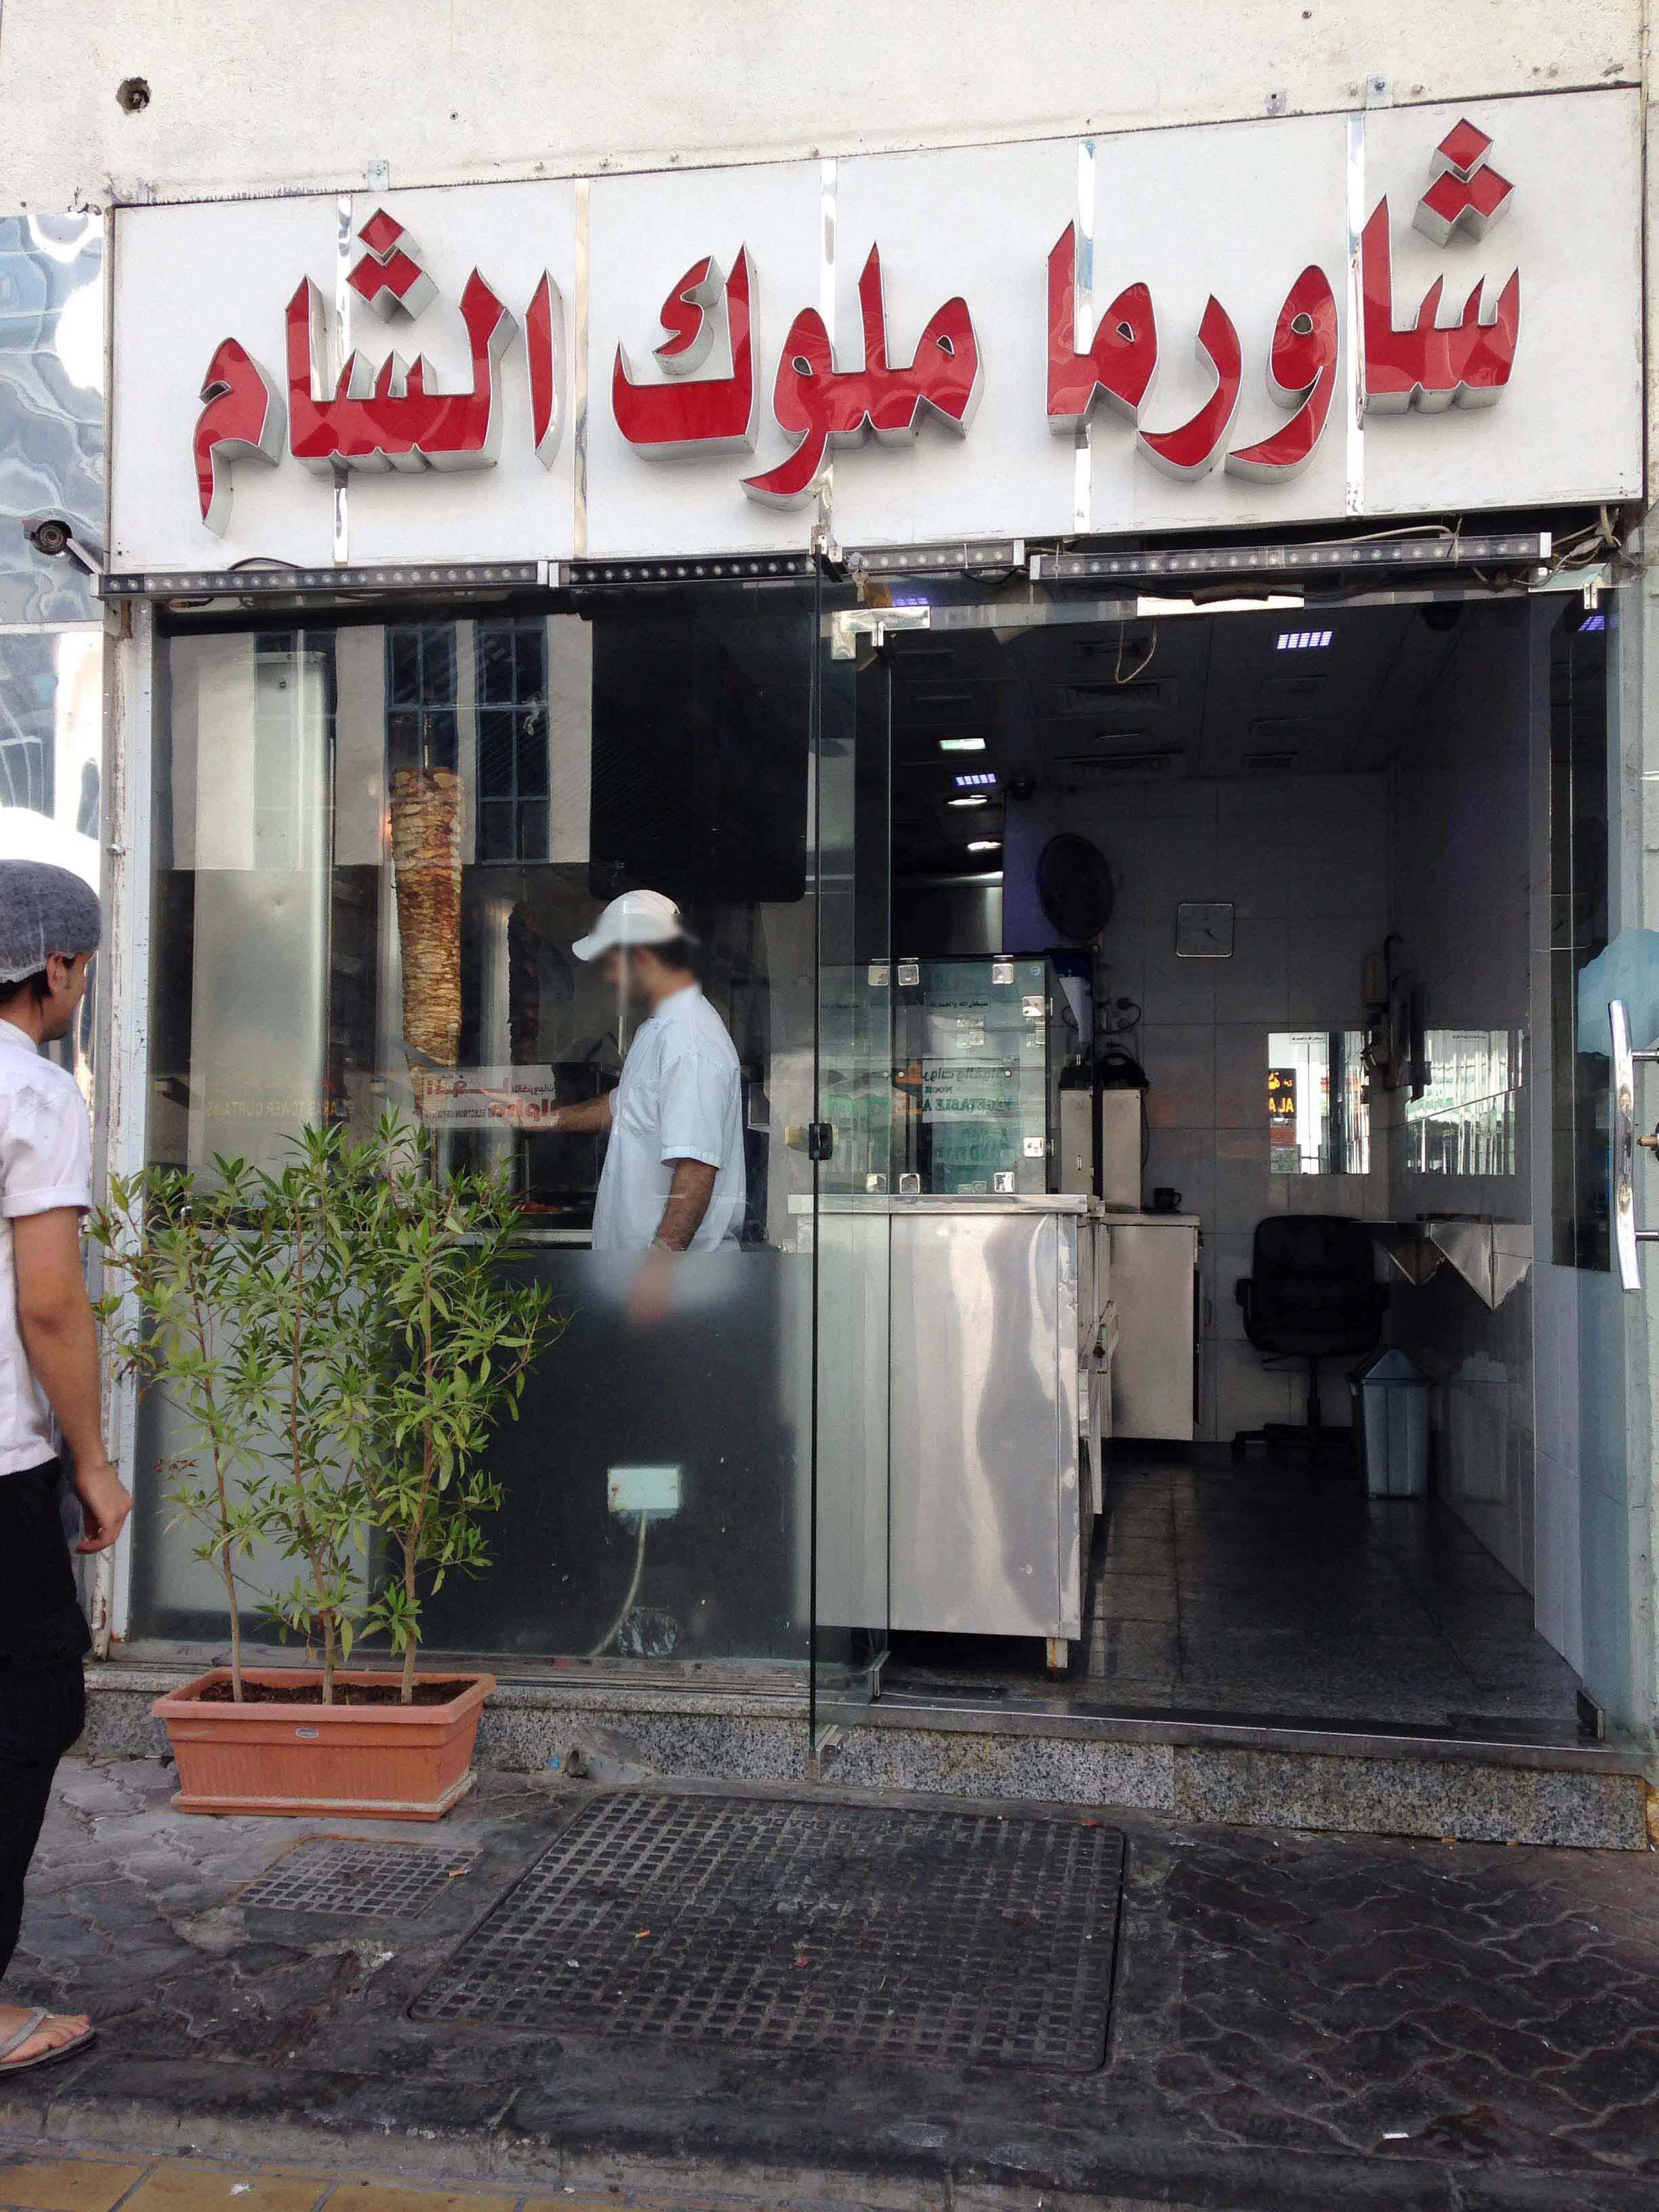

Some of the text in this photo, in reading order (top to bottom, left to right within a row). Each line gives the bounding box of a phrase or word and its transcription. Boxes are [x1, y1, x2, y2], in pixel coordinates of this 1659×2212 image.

[192, 118, 1521, 539] شاورما ملوك الشام
